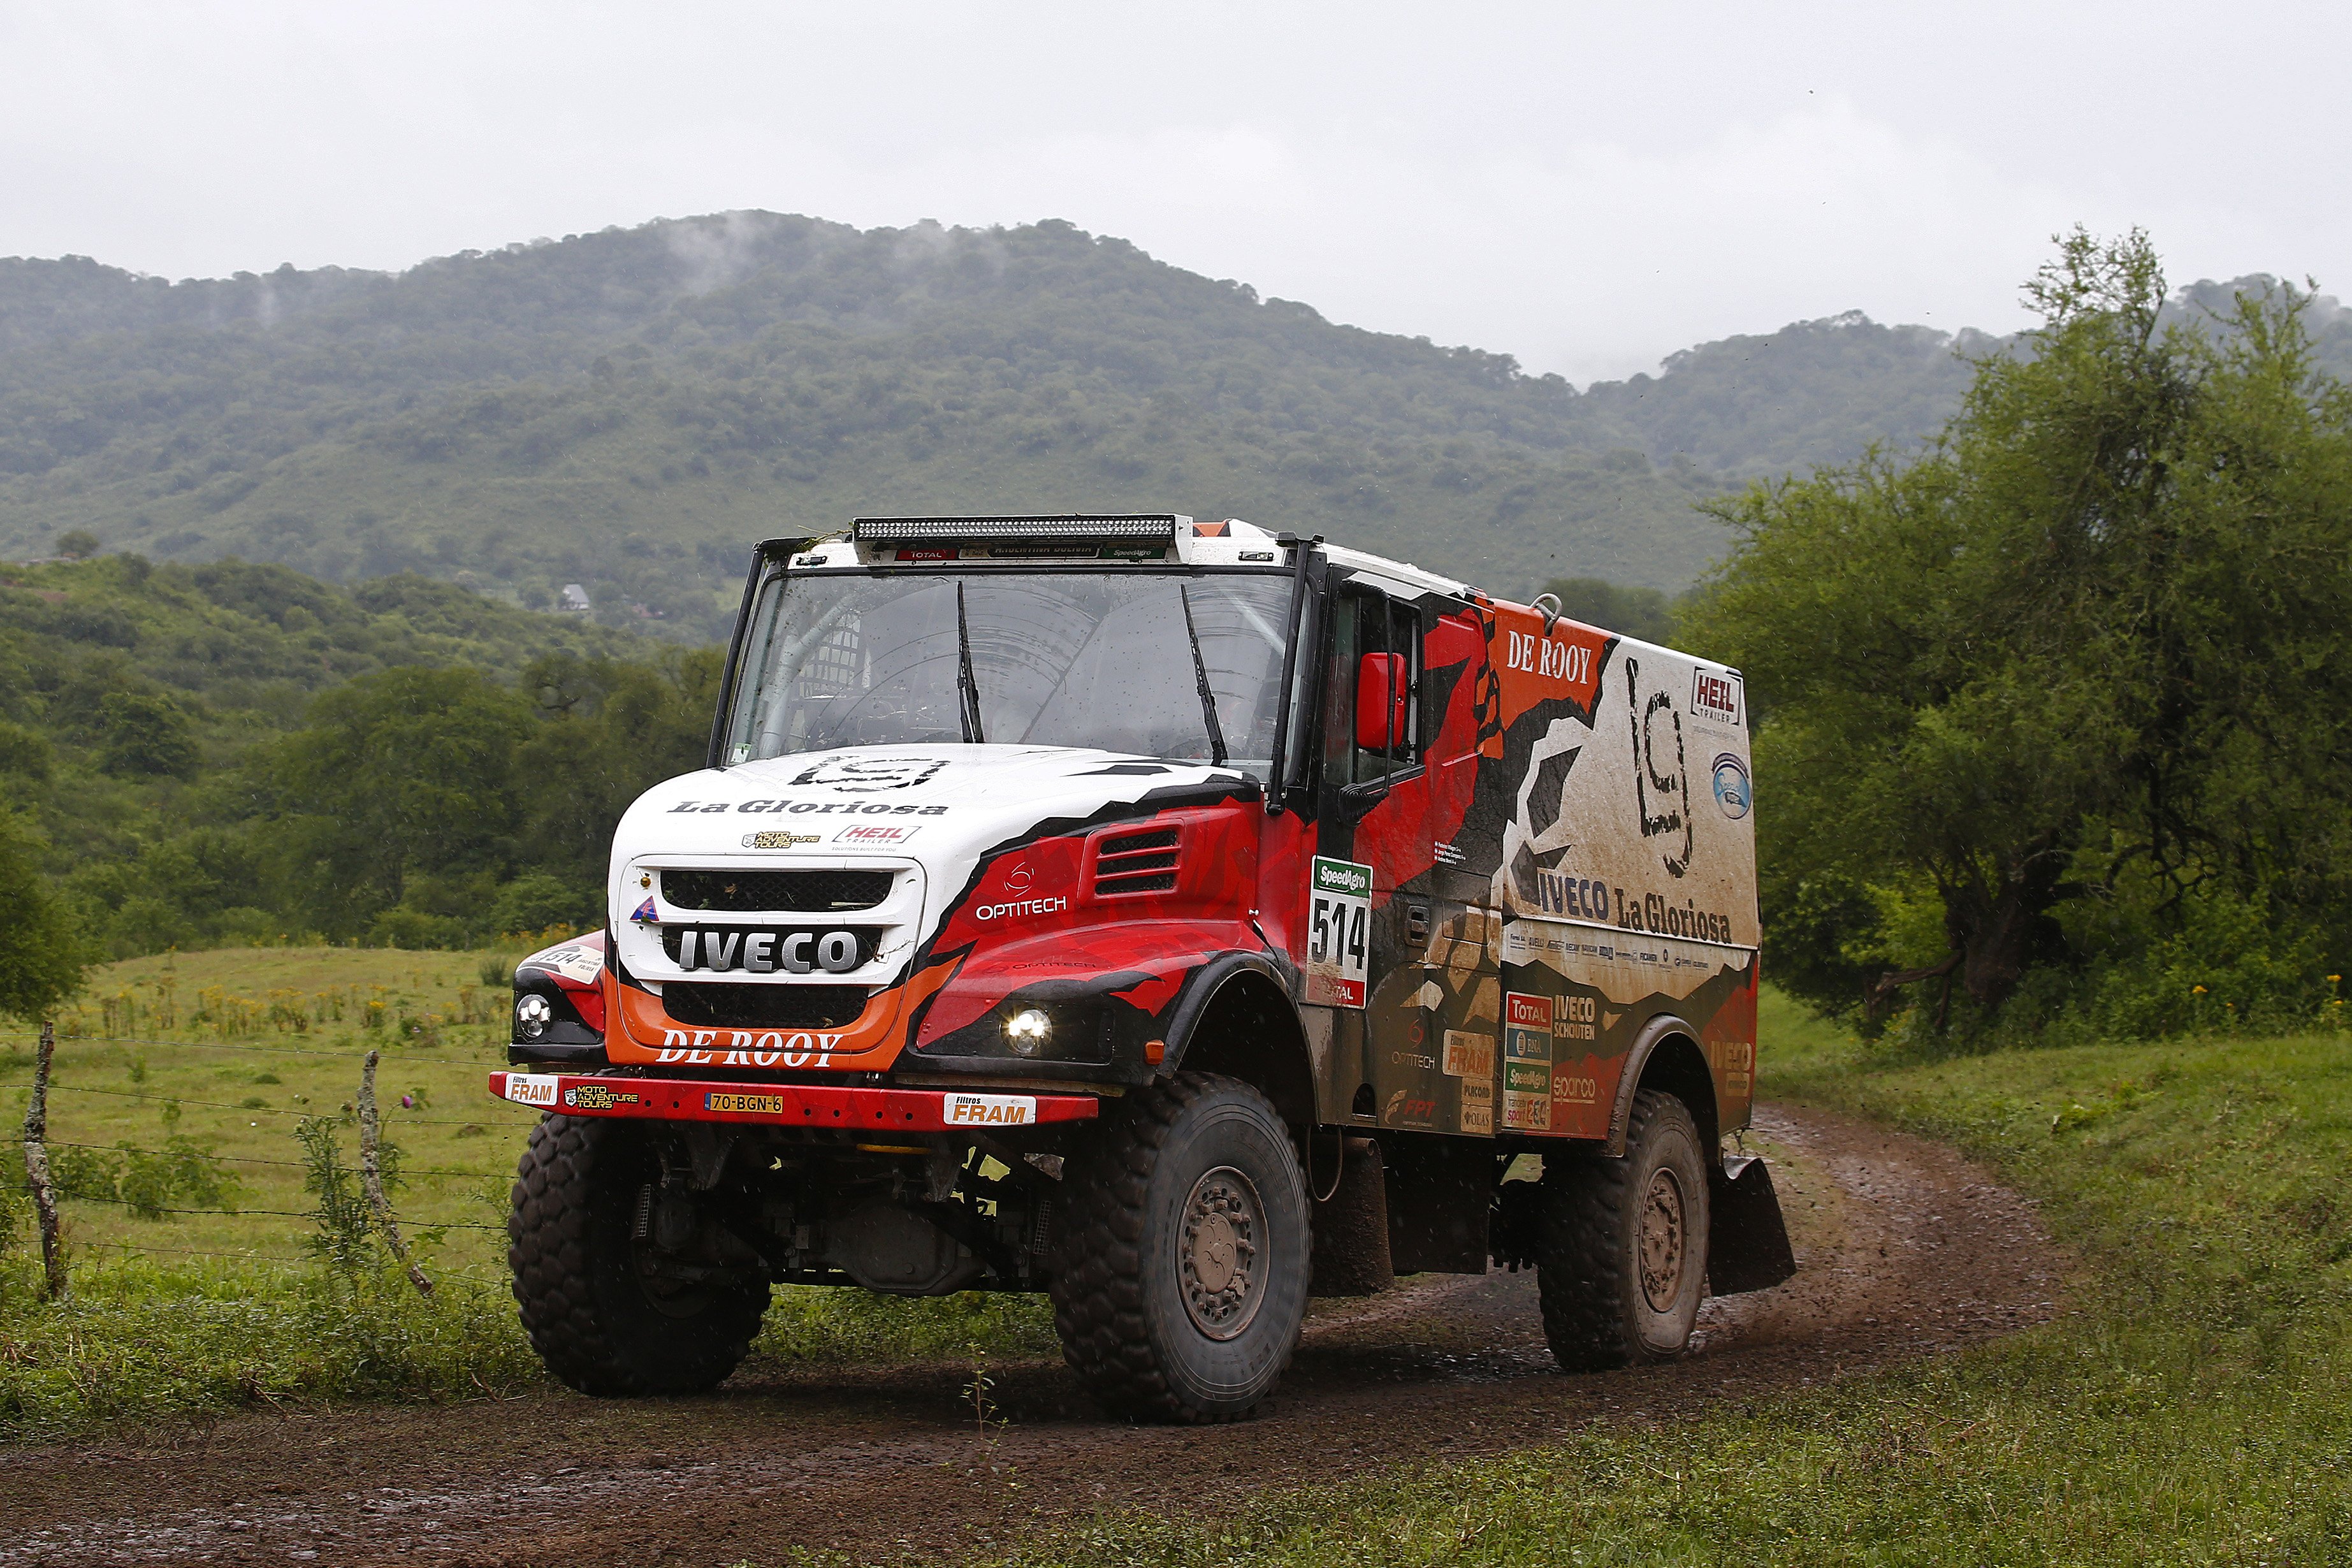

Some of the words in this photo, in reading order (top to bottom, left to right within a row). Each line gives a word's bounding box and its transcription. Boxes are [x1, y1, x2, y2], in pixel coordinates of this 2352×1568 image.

[1114, 549, 1152, 557] SpeedAgro
[1507, 630, 1535, 672] DE
[1538, 638, 1592, 685] ROOY
[1697, 674, 1734, 713] HEIL
[1699, 708, 1731, 723] TRAILER
[666, 800, 732, 813] La
[737, 799, 949, 816] Gloriosa
[845, 827, 904, 839] HEIL
[1320, 865, 1366, 890] SpeedAgro
[1539, 873, 1609, 920] IVECO
[975, 896, 1067, 920] OPTITECH
[1614, 887, 1644, 931] La
[1645, 892, 1732, 945] Gloriosa
[1311, 897, 1366, 970] 514
[545, 952, 583, 964] 514
[679, 931, 857, 973] IVECO
[1012, 962, 1096, 970] OPTITECH
[1513, 999, 1547, 1023] TOTAL
[1555, 994, 1595, 1022] IVECO
[1554, 1022, 1595, 1041] SCHOUTEN
[655, 1029, 718, 1064] DE
[723, 1031, 844, 1068] ROOY
[1391, 1051, 1435, 1069] OPTITECH
[1448, 1046, 1490, 1074] FRAM
[1511, 1068, 1546, 1089] SpeedAgro
[1553, 1076, 1595, 1100] sparco
[511, 1083, 553, 1102] FRAM
[577, 1085, 607, 1094] MOTO
[577, 1093, 639, 1103] ADVENTURE
[577, 1100, 613, 1108] TOURS
[713, 1096, 781, 1112] 70-BGN-6
[956, 1096, 982, 1105] Filtros
[1404, 1100, 1437, 1118] FPT
[952, 1104, 1026, 1124] FRAM
[1507, 1108, 1526, 1124] sport
